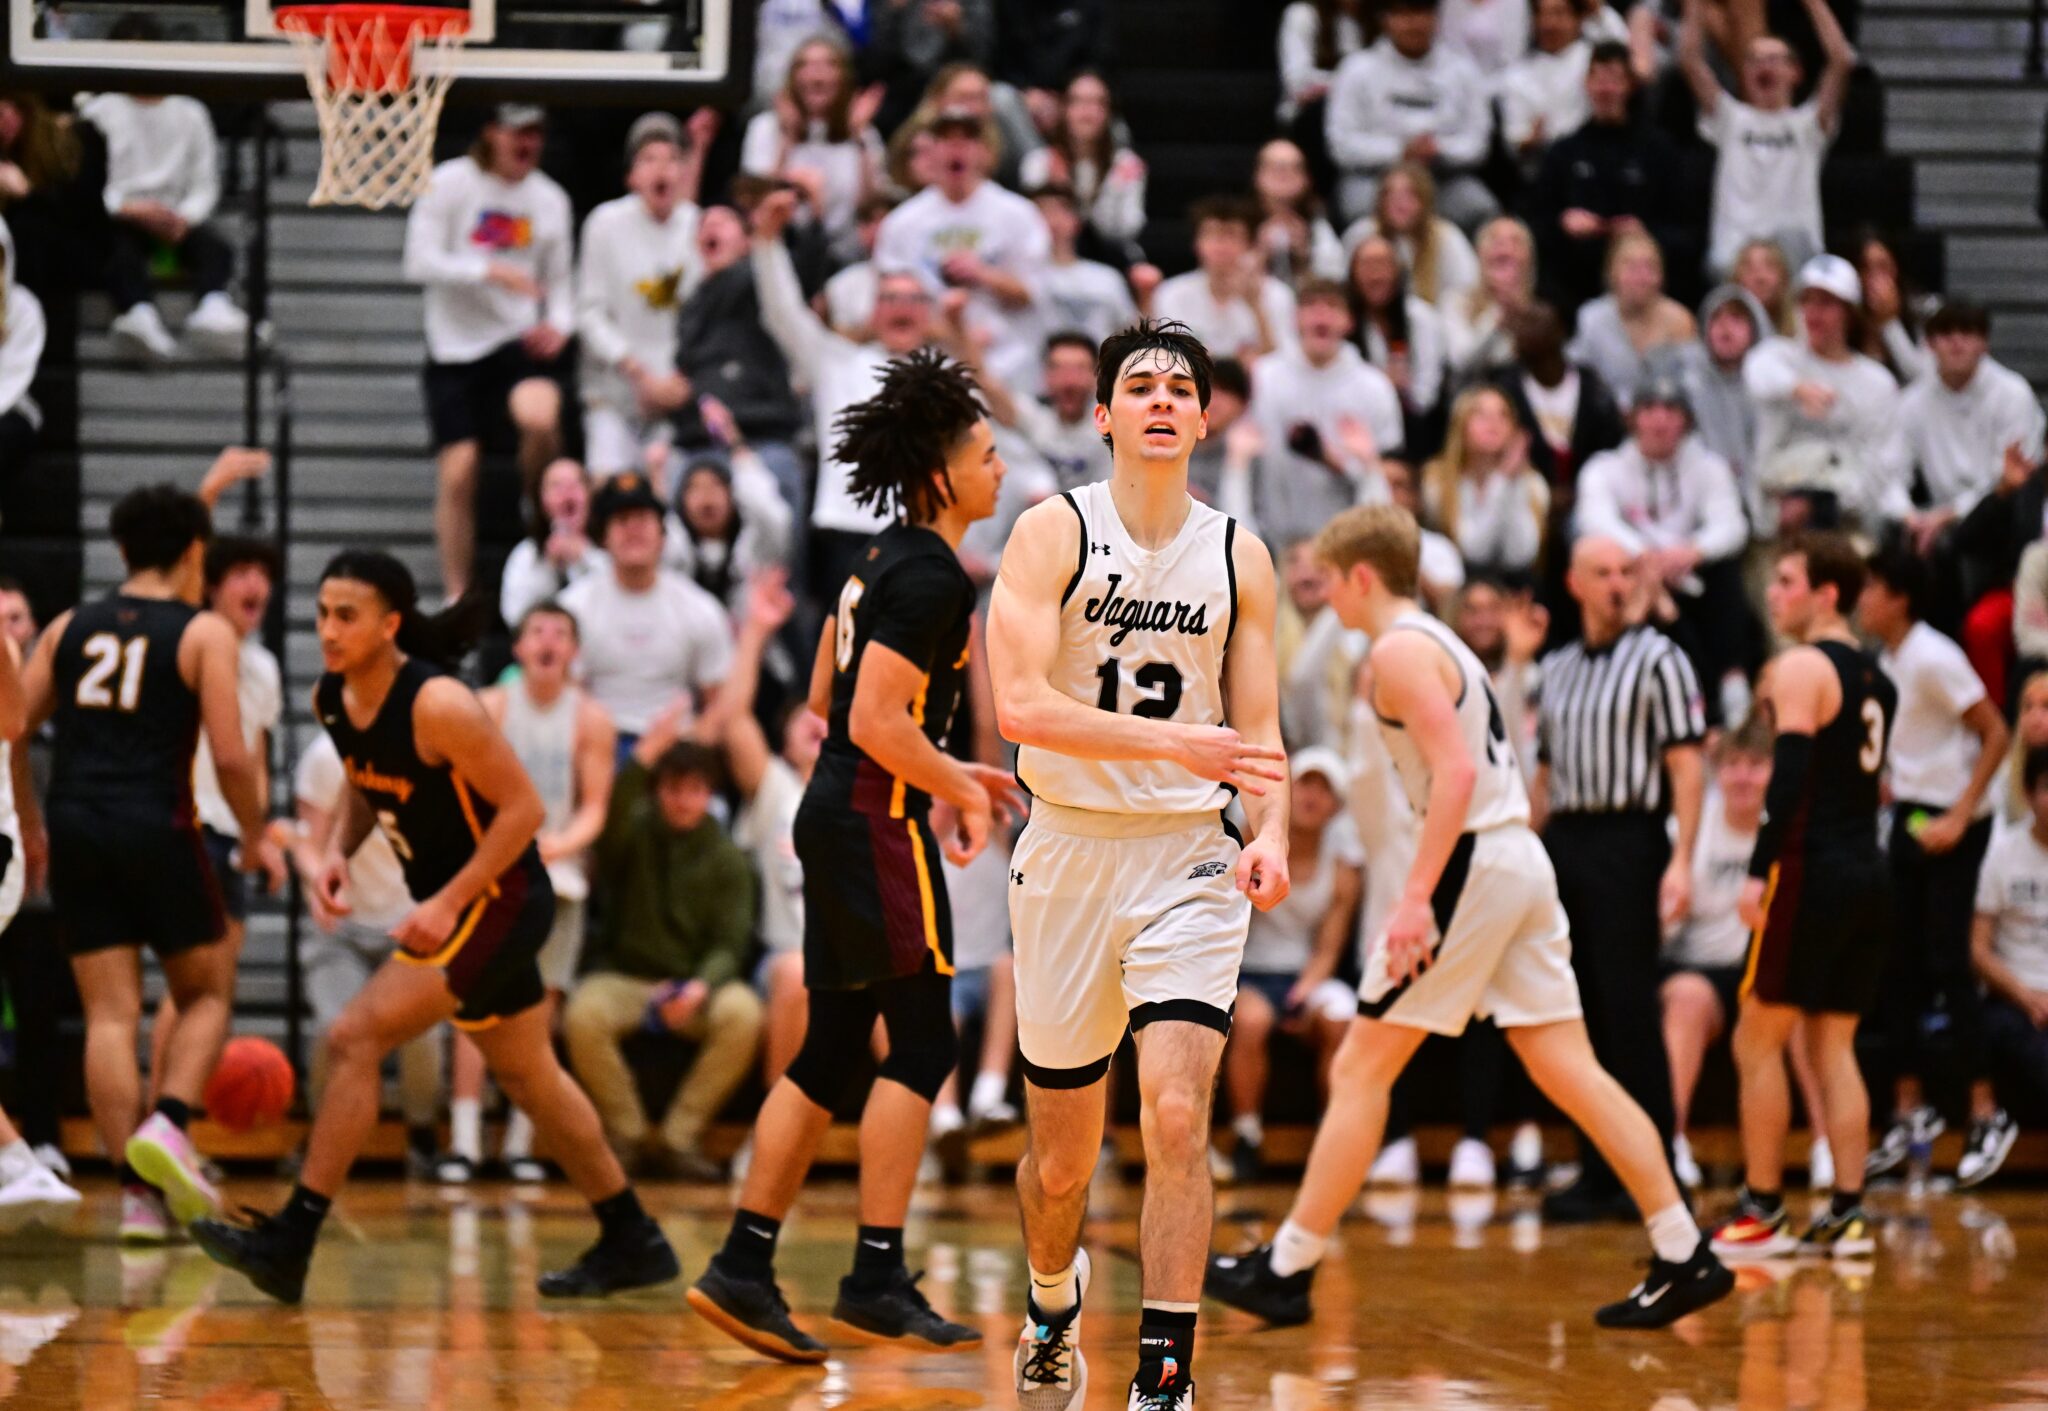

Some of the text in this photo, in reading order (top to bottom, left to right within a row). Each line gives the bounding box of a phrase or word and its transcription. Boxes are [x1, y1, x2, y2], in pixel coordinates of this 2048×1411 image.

[1084, 573, 1209, 647] Jaguars
[76, 632, 148, 710] 21
[1096, 656, 1184, 718] 12
[1859, 696, 1885, 774] 3
